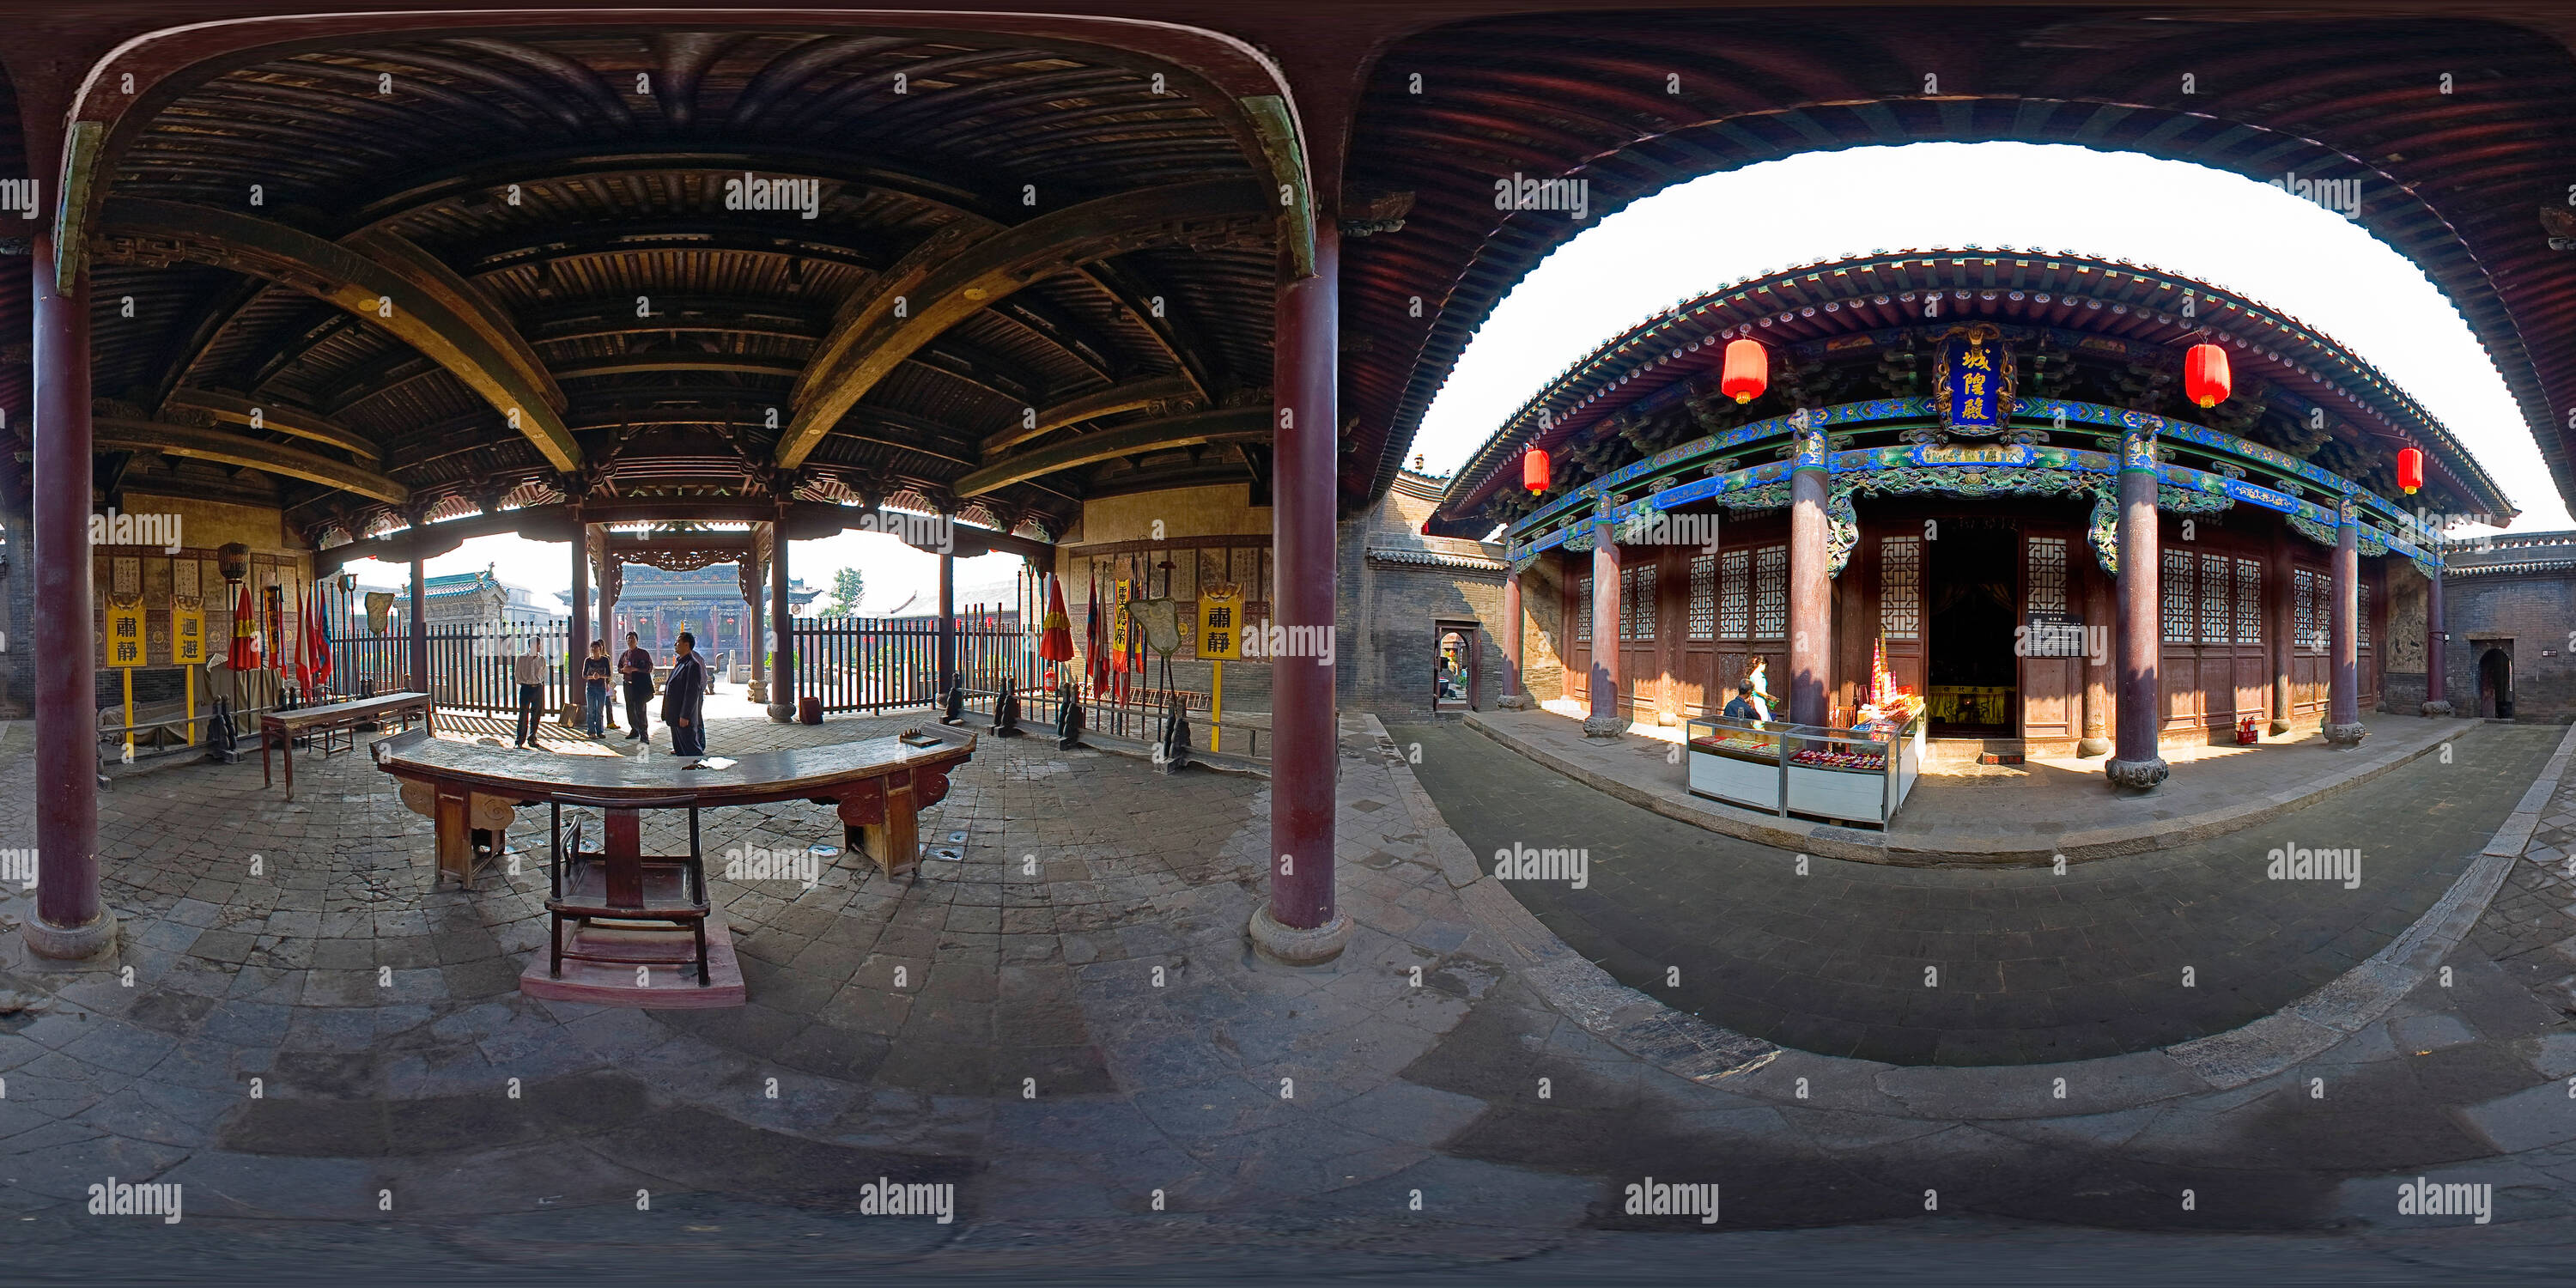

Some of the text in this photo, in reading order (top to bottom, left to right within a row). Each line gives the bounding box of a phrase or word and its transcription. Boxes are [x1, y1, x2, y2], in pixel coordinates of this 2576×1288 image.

[1962, 349, 1991, 420] 城隍殿
[117, 617, 137, 660] 肅靜
[180, 617, 198, 658] 迴避
[1208, 606, 1231, 653] 肅靜
